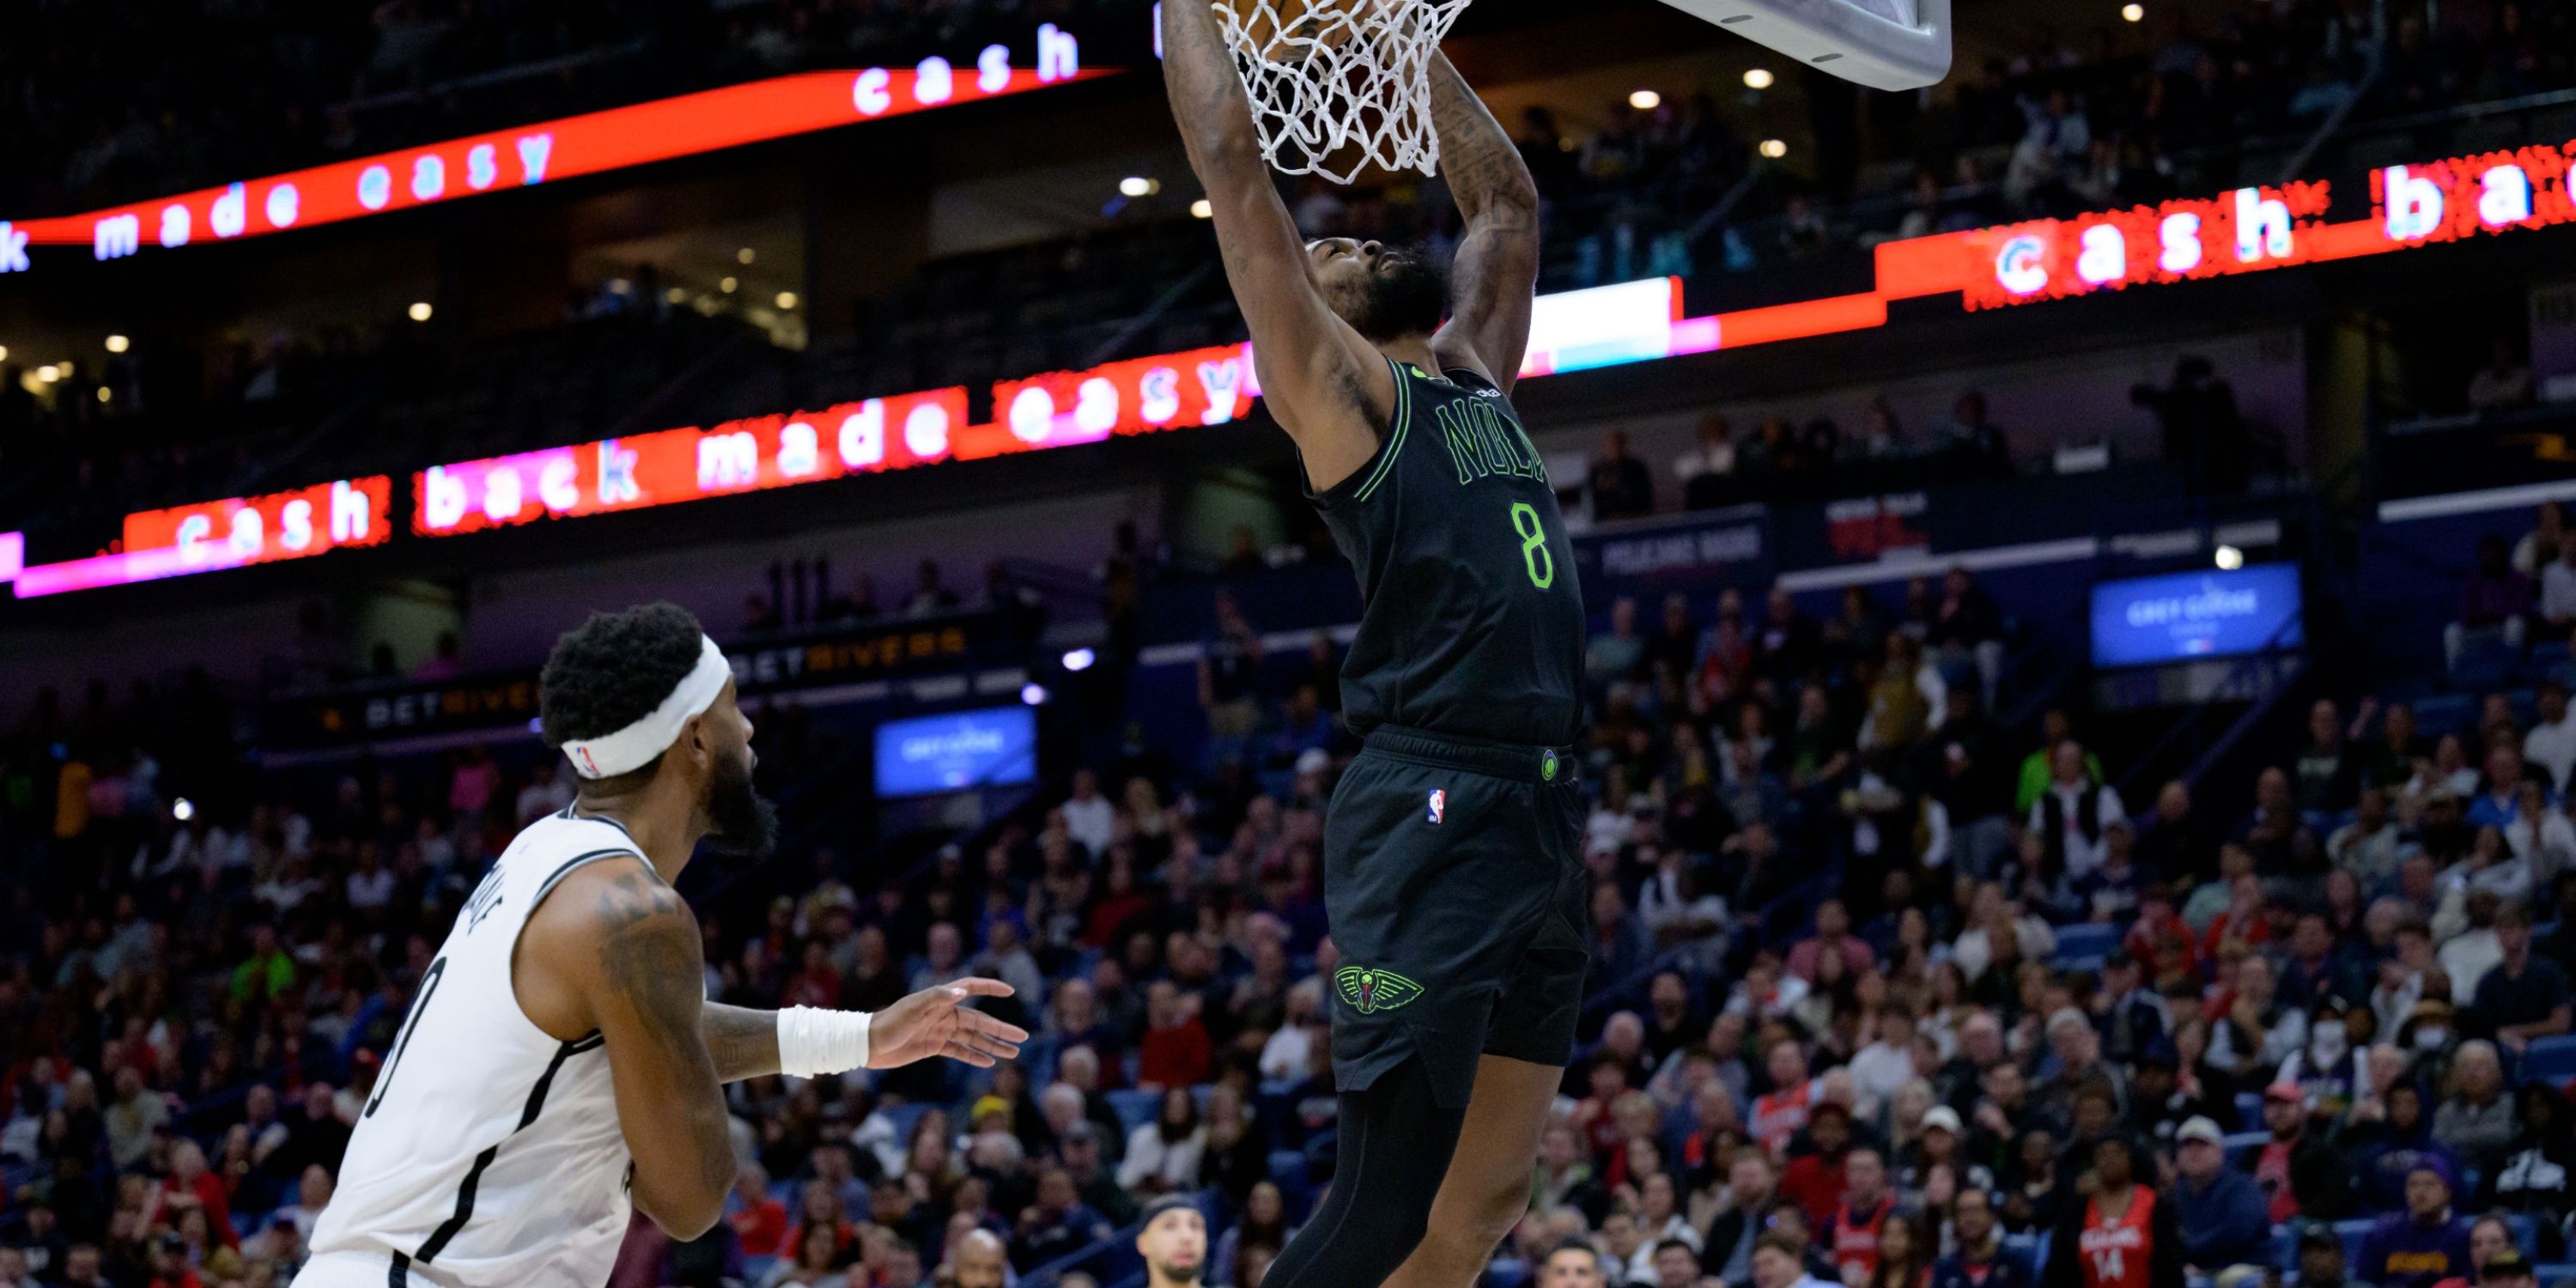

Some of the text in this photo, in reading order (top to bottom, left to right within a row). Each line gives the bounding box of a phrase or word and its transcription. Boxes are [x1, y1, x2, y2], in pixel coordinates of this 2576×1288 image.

[94, 181, 299, 261] made
[357, 133, 554, 210] easy
[853, 22, 1078, 115] cash
[1996, 186, 2292, 295] cash
[177, 357, 1243, 564] cash back made easy
[1436, 396, 1555, 487] NOLA
[1510, 501, 1553, 590] 8
